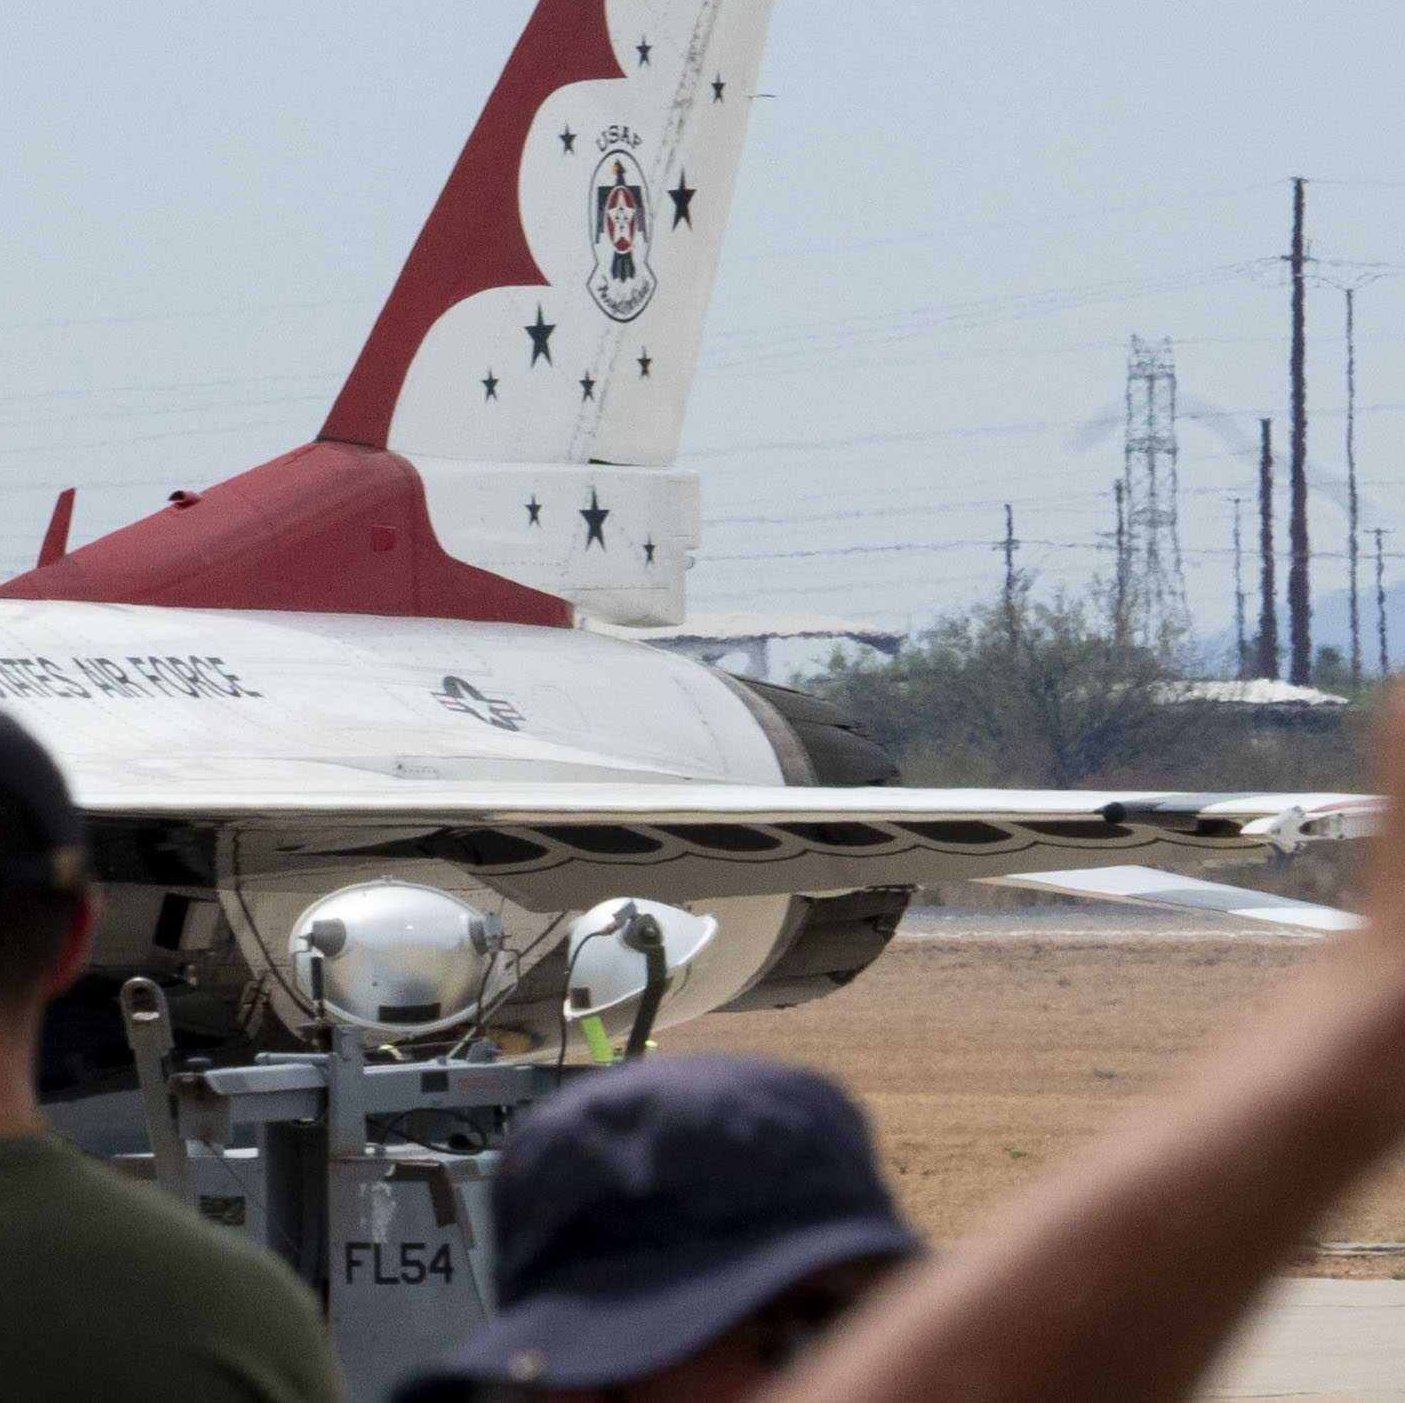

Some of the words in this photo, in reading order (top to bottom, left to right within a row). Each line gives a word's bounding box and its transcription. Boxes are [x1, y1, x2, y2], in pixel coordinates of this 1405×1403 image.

[595, 125, 643, 152] USAF
[71, 656, 156, 699] AIR
[125, 655, 265, 699] FORCE
[345, 1242, 454, 1285] FL54
